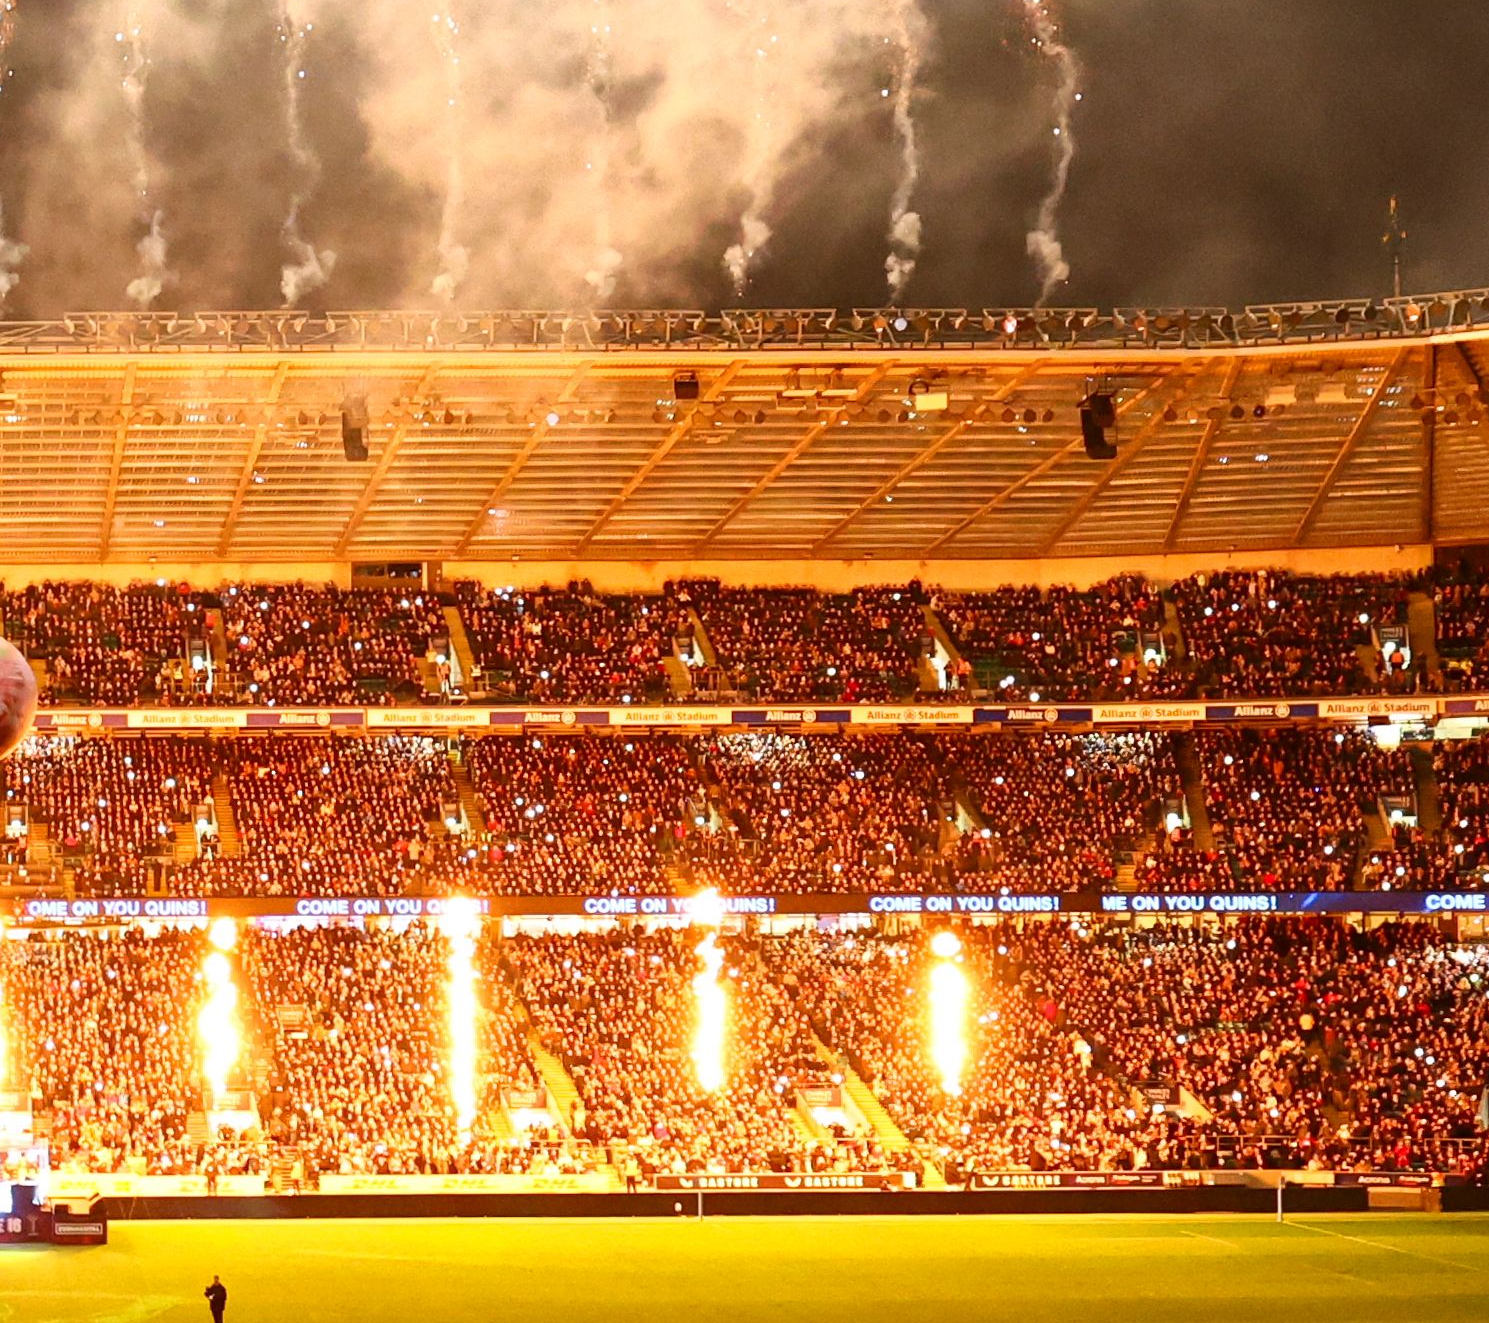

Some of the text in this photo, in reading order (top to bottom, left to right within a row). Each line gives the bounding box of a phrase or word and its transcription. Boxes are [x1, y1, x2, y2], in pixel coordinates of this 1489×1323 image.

[1007, 710, 1042, 720] Allianz
[1100, 707, 1199, 718] Allianz Stadium
[1234, 705, 1275, 716] Allianz
[1326, 701, 1429, 714] Allianz Stadium
[28, 900, 207, 916] OME ON YOU QUINS!
[298, 899, 348, 915] COME
[354, 899, 379, 915] ON
[385, 899, 421, 915] YOU
[585, 898, 635, 914] COME
[641, 898, 666, 913] ON
[726, 897, 775, 913] UINS!
[870, 896, 1059, 912] COME ON YOU QUINS!
[1102, 896, 1276, 912] ME ON YOU QUINS!
[1425, 894, 1485, 910] COME
